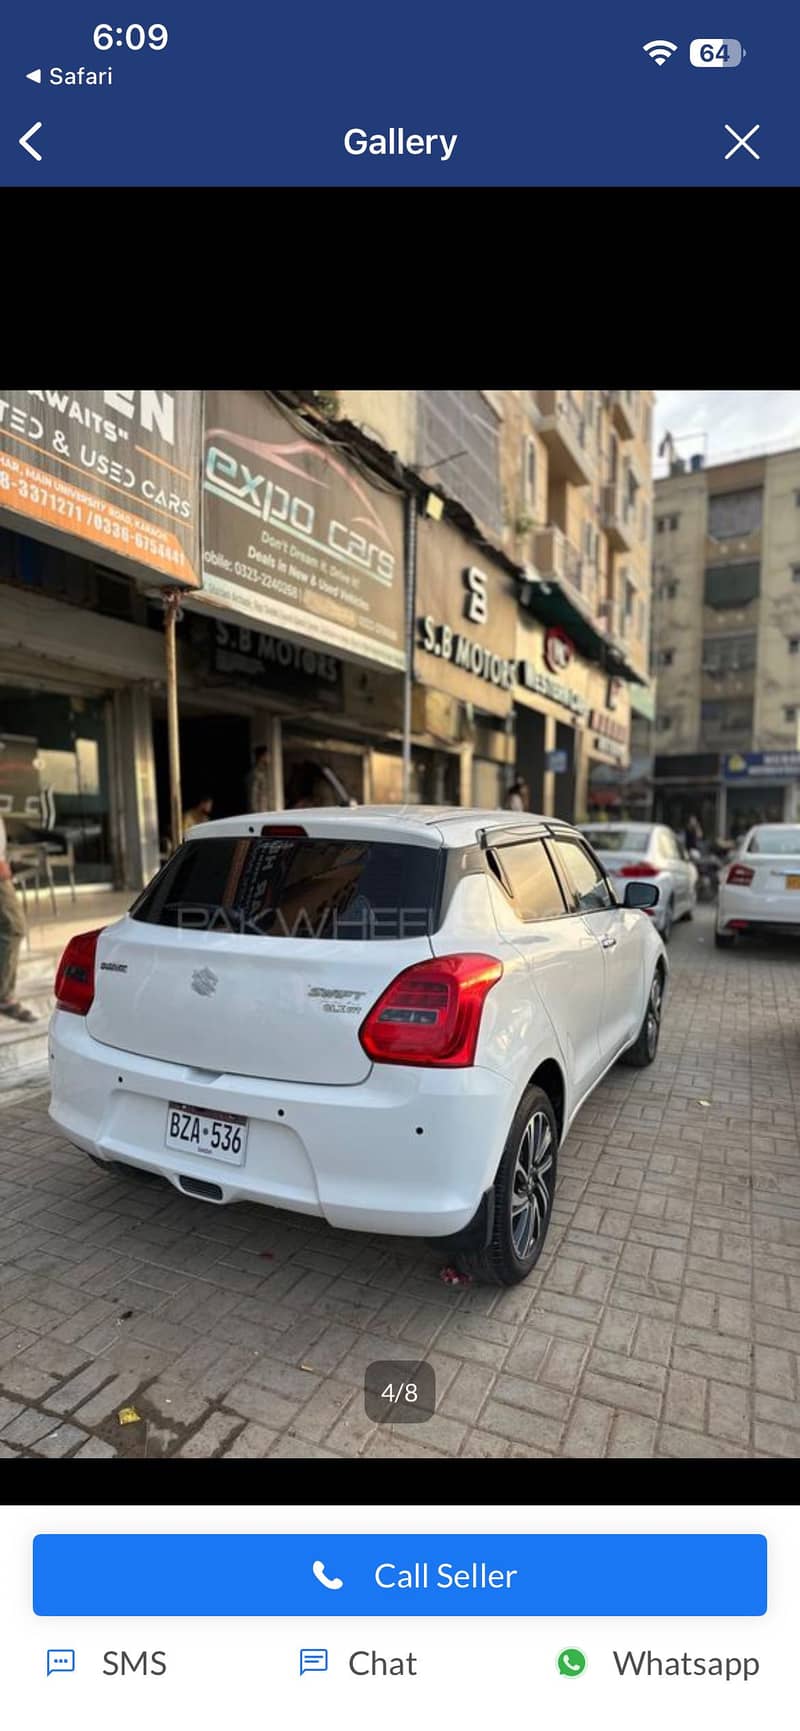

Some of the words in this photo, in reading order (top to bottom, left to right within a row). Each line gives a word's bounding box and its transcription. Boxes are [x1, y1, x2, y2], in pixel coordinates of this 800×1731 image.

[53, 430, 70, 457] &
[81, 445, 135, 488] USED
[142, 481, 190, 518] CARS
[206, 447, 315, 534] expo
[248, 545, 276, 569] Deals
[328, 519, 395, 580] cars
[258, 632, 338, 681] MOTORS
[424, 615, 452, 659] S.B
[456, 635, 517, 690] MOTORS
